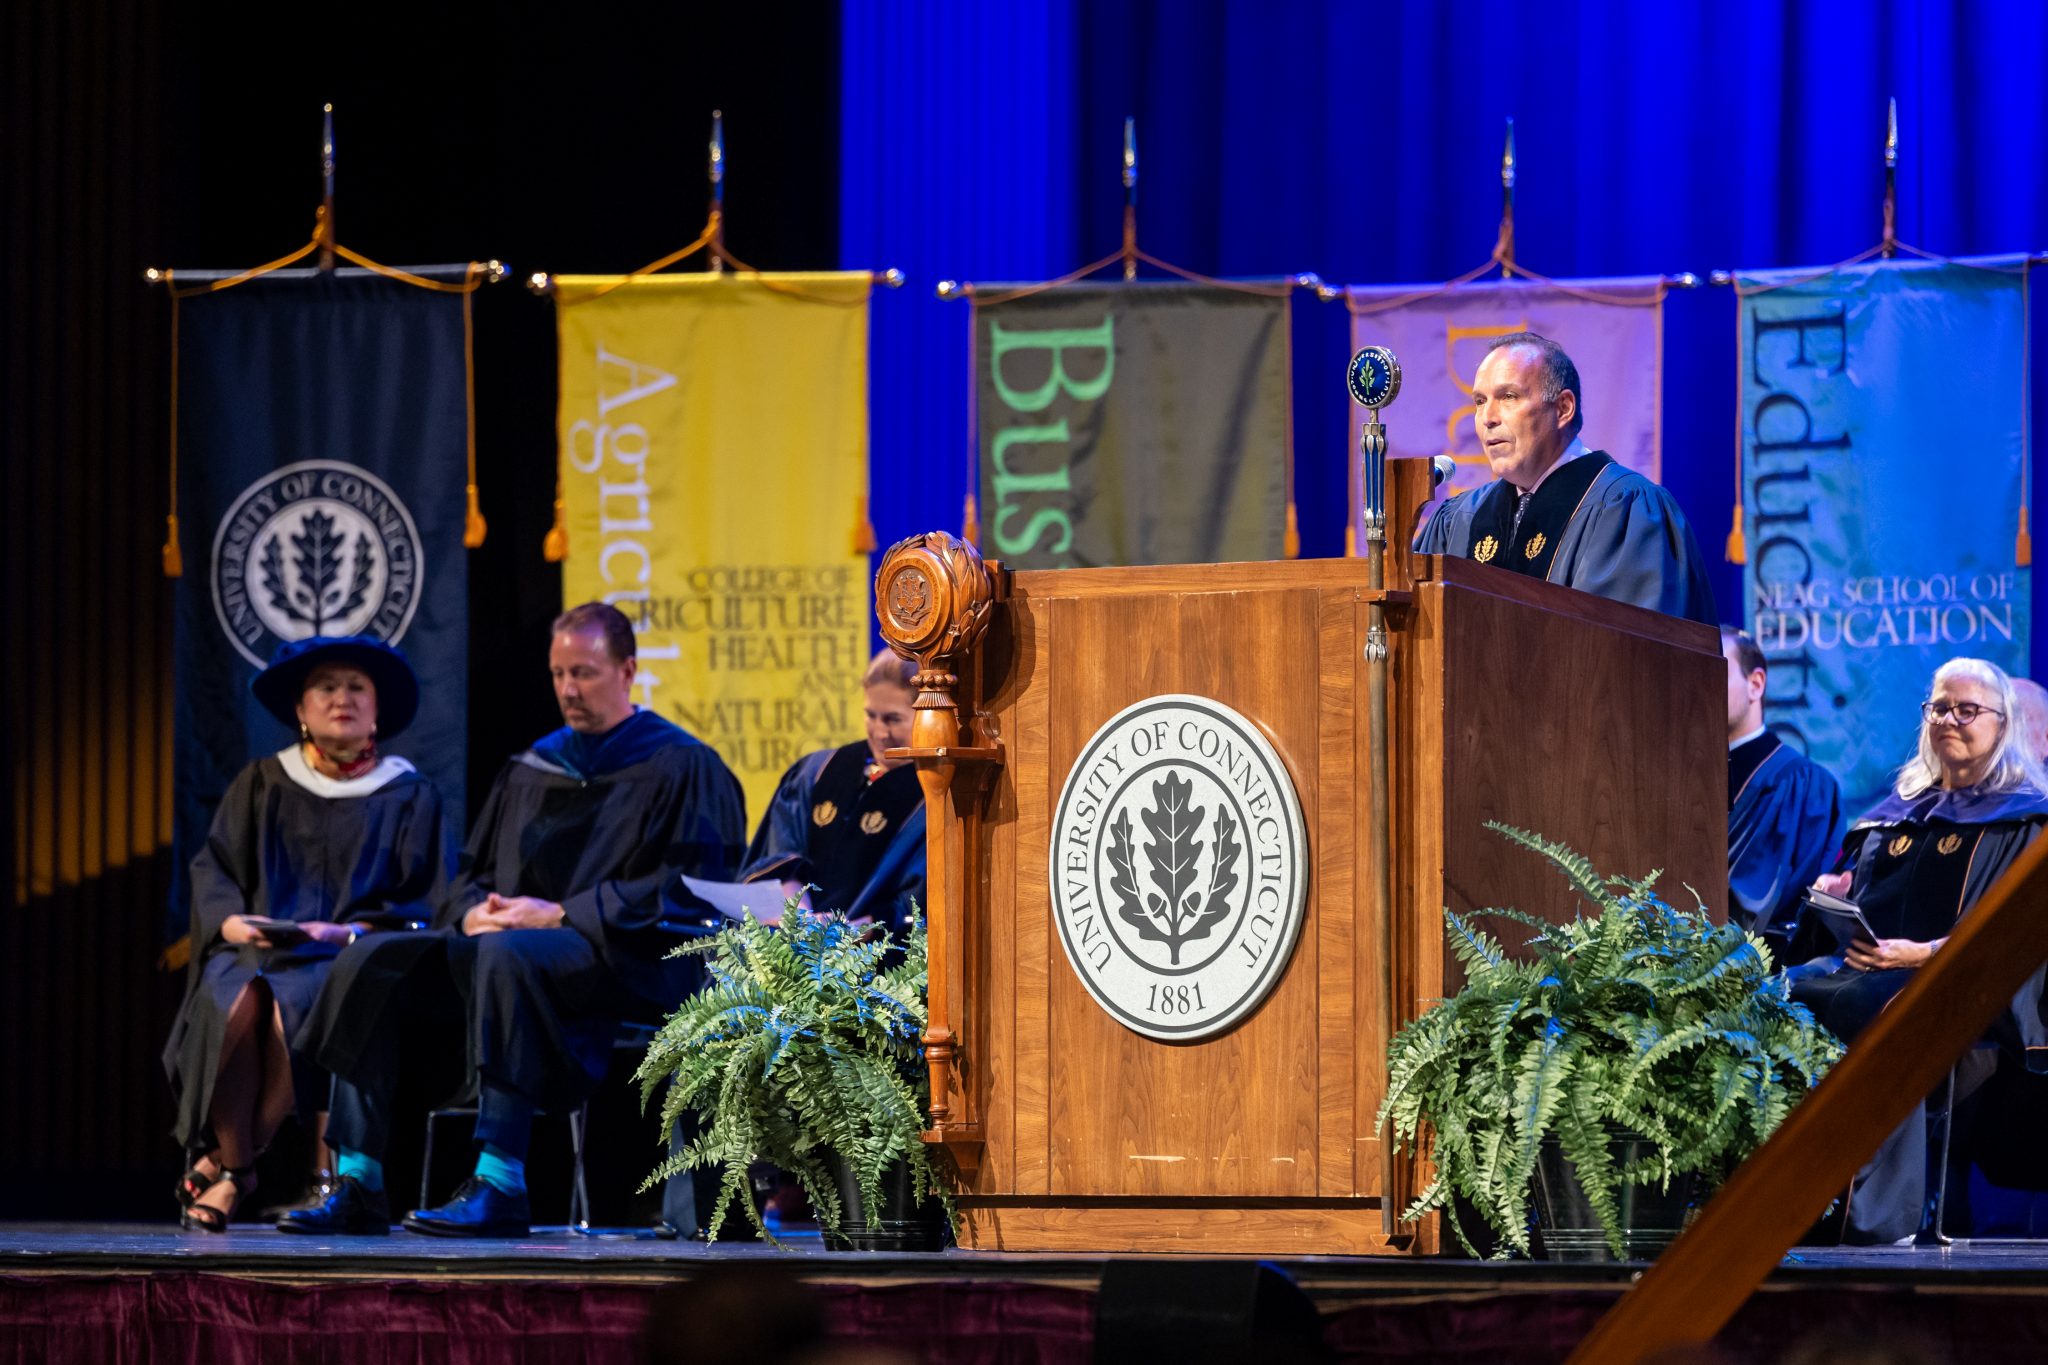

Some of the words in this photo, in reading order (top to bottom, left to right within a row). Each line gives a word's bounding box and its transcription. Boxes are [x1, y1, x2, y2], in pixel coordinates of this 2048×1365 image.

[990, 313, 1116, 560] Bus
[220, 487, 278, 646] UNIVERSITY
[281, 472, 317, 501] OF
[321, 471, 413, 643] CONNECTICUT
[687, 566, 802, 593] COLLEGE
[814, 564, 852, 592] OF
[1753, 579, 1830, 610] NEAG
[1842, 573, 1967, 607] SCHOOL
[1969, 571, 2015, 601] OF
[1754, 602, 2014, 651] EDUCATION
[707, 632, 859, 673] HEALTH
[800, 671, 860, 695] AND
[673, 698, 855, 736] NATURAL
[1066, 743, 1126, 974] UNIVERSITY
[1130, 720, 1170, 758] OF
[1177, 720, 1284, 970] CONNECTICUT
[1145, 981, 1208, 1016] 1881
